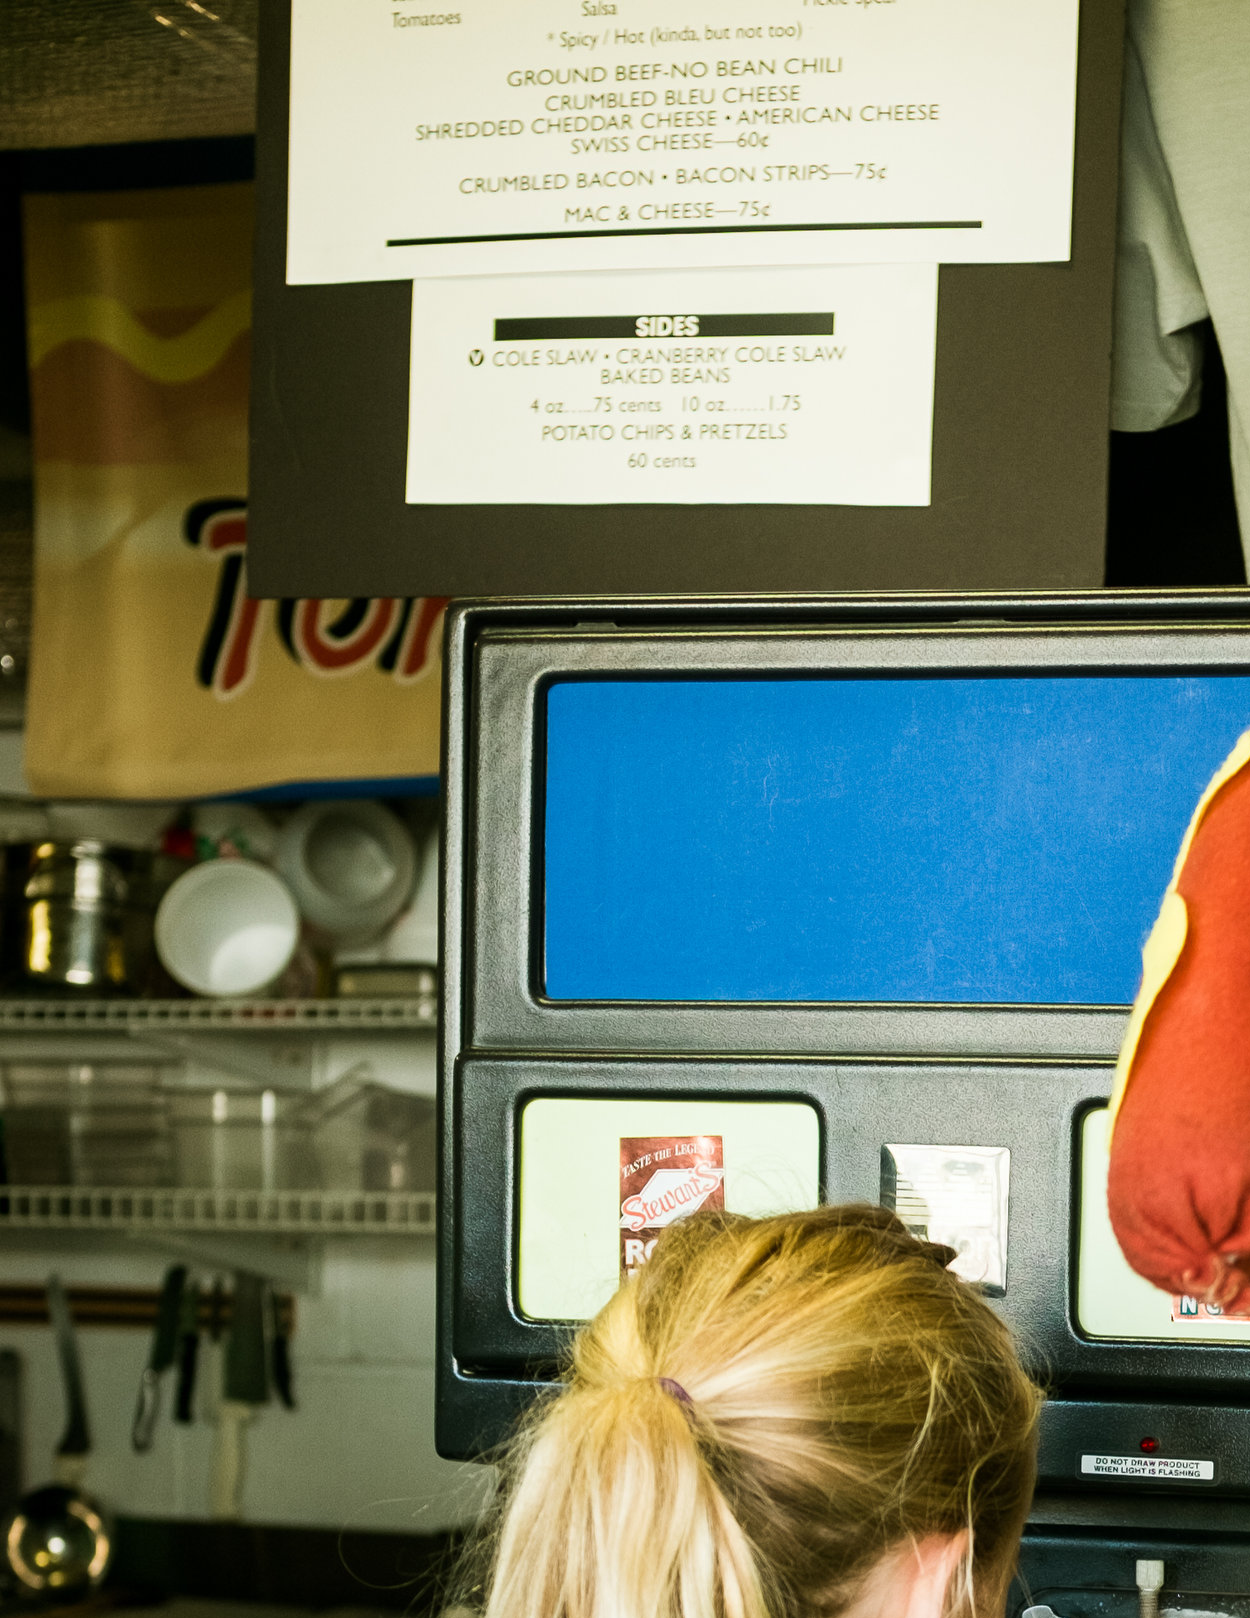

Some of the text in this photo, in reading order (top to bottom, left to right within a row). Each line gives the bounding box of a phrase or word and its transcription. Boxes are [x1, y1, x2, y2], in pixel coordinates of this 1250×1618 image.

[581, 0, 618, 17] Salsa
[392, 12, 461, 28] Tomatoes
[559, 30, 599, 51] Spicy
[614, 28, 645, 44] Hot
[704, 25, 730, 40] but
[736, 27, 763, 39] not
[768, 21, 803, 41] too)
[506, 66, 608, 87] GROUND
[715, 59, 777, 77] BEAN
[783, 57, 843, 75] CHILI
[544, 84, 801, 112] CRUMBLED BLEU CHEESE
[415, 103, 940, 141] SHREDDED CHEDDAR CHEESE AMERICAN CHEESE
[570, 136, 630, 155] SWISS
[458, 174, 570, 194] CRUMBLED
[575, 170, 654, 189] BACON
[675, 166, 756, 186] BACON
[564, 205, 610, 224] MAC
[616, 205, 631, 221] &
[634, 315, 700, 338] SIDES
[492, 350, 541, 367] COLE
[545, 349, 599, 366] SLAW
[615, 347, 729, 365] CRANBERRY
[734, 346, 787, 363] COLE
[791, 345, 847, 362] SLAW
[600, 367, 732, 385] BAKED BEANS
[530, 398, 539, 413] 4
[618, 399, 662, 413] cents
[681, 396, 700, 412] 10
[541, 422, 788, 441] POTATO CHIPS & PRETZELS
[627, 452, 697, 468] 60 cents
[621, 1153, 651, 1179] TASTE
[653, 1148, 672, 1162] THE
[1093, 1465, 1201, 1477] WHEN LIGHT IS FLASHING
[1095, 1457, 1200, 1470] DO NOT DRAW PRODUCT
